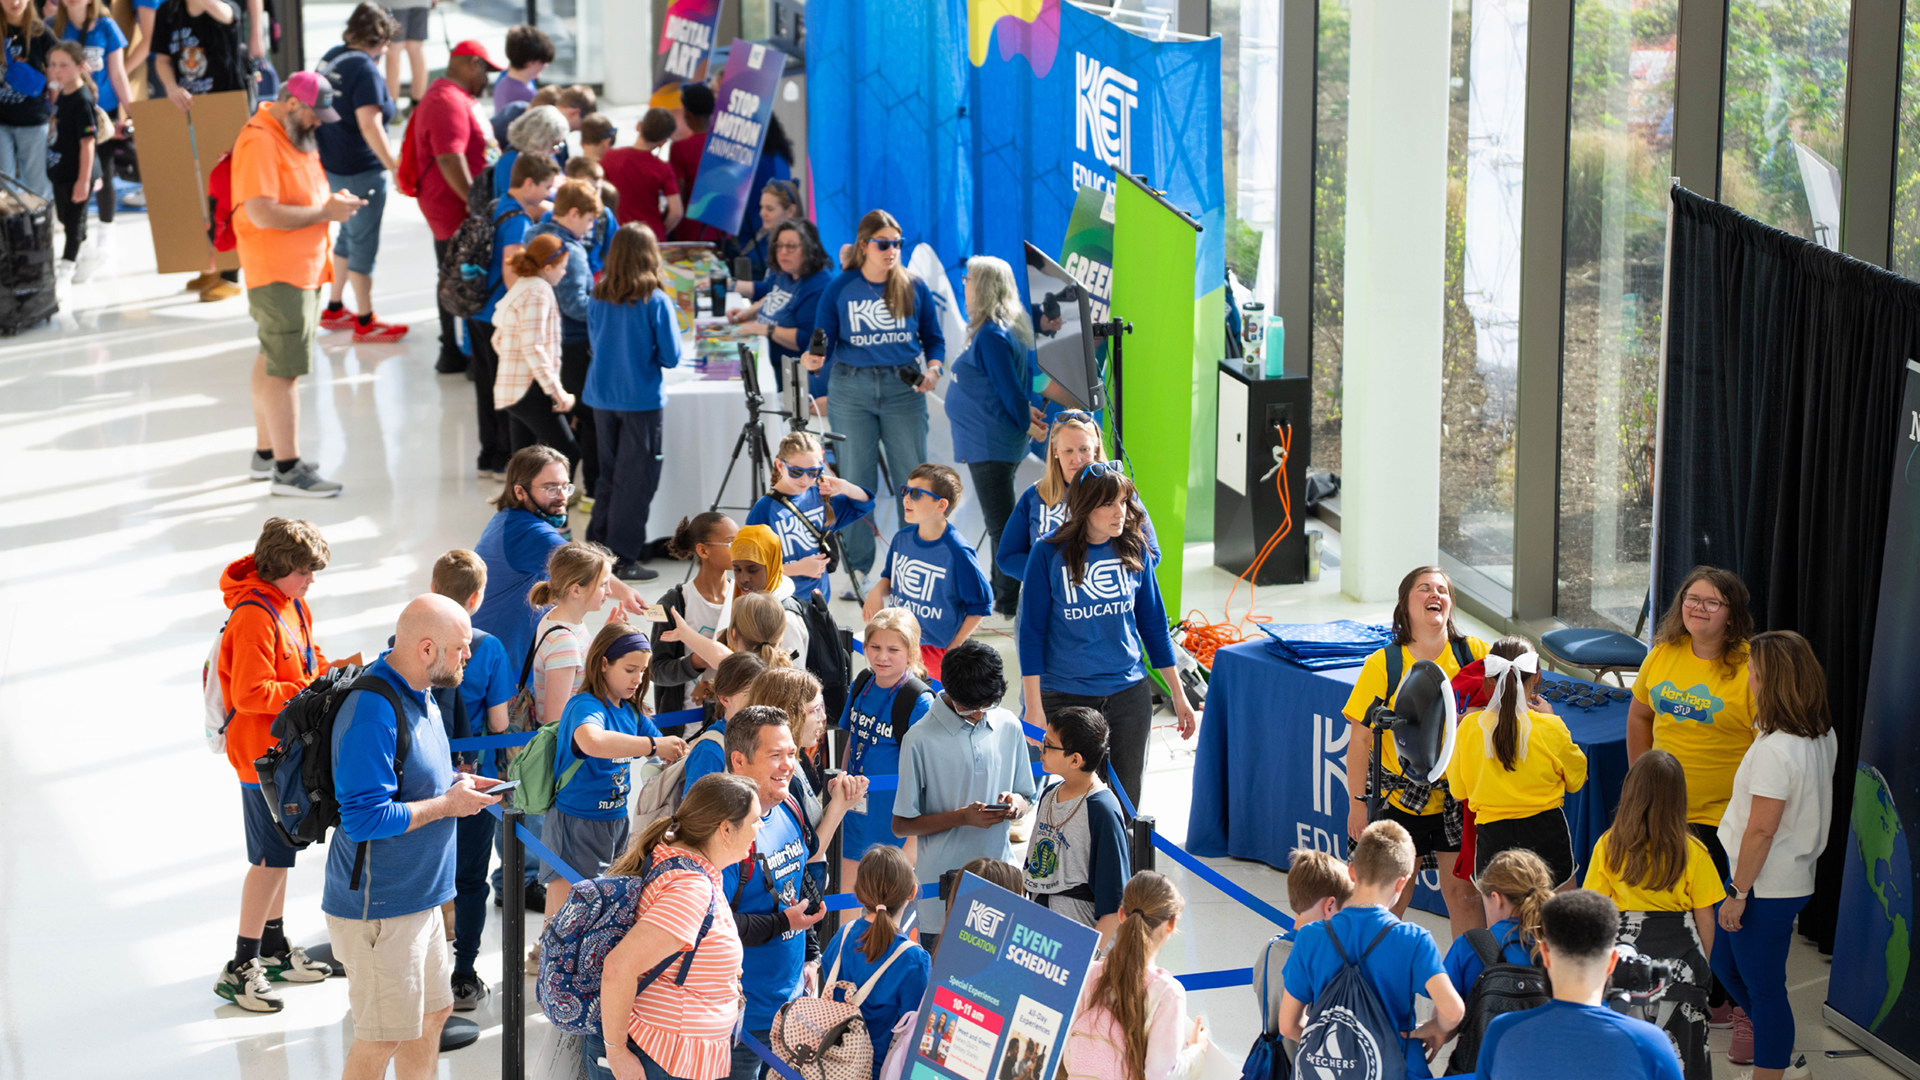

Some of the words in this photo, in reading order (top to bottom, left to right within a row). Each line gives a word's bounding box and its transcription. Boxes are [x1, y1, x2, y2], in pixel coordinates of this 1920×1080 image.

[665, 14, 711, 51] DIGITAL
[664, 40, 702, 80] ART
[727, 88, 760, 119] STOP
[1076, 51, 1138, 174] KET
[713, 110, 762, 148] MOTION
[706, 136, 756, 167] ANIMATION
[850, 331, 912, 347] EDUCATION
[890, 551, 947, 602] KET
[964, 899, 1006, 939] KET
[958, 929, 997, 955] EDUCATION
[1012, 923, 1063, 960] EVENT
[1005, 944, 1070, 987] SCHEDULE
[948, 975, 969, 991] Special
[967, 983, 1000, 1007] Experiences
[952, 997, 972, 1016] 10-11
[970, 1009, 985, 1023] am
[1019, 1014, 1051, 1036] Experiences
[1305, 1052, 1355, 1069] SKECHERS
